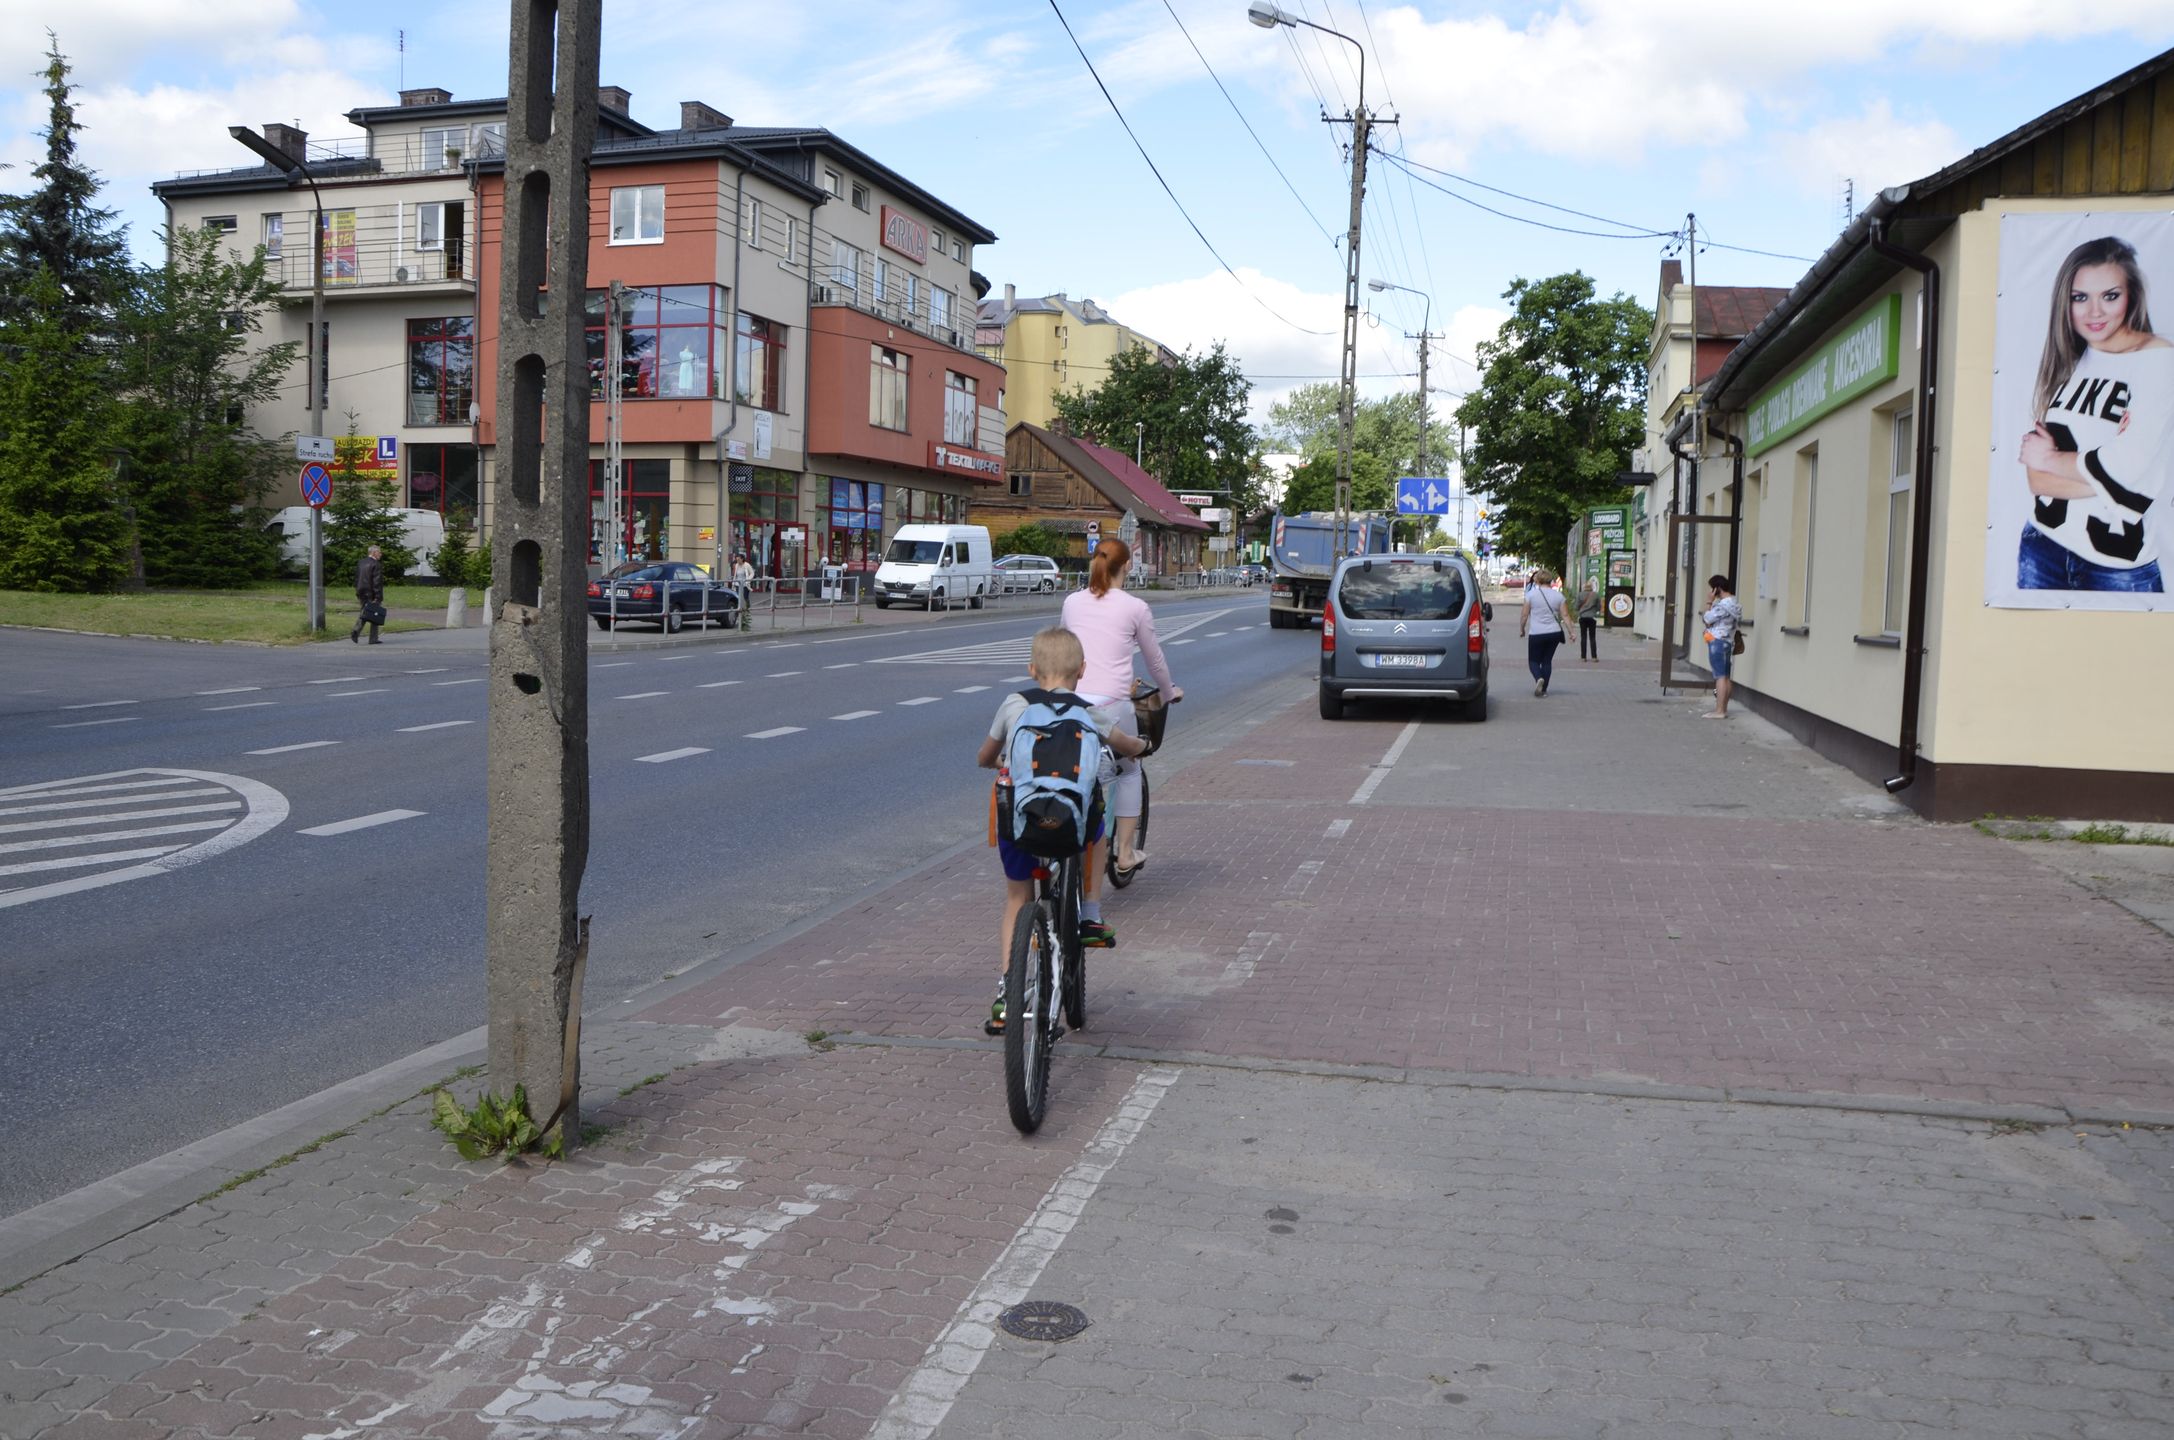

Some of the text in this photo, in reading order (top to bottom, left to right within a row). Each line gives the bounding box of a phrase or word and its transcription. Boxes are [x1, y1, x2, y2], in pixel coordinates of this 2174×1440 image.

[886, 213, 926, 262] ARKA
[1832, 316, 1881, 394] AKCESORIA
[2050, 378, 2131, 423] LIKE
[300, 448, 333, 459] Strefa ruchu
[1594, 514, 1620, 524] LOOMBARD
[1381, 656, 1394, 664] WM
